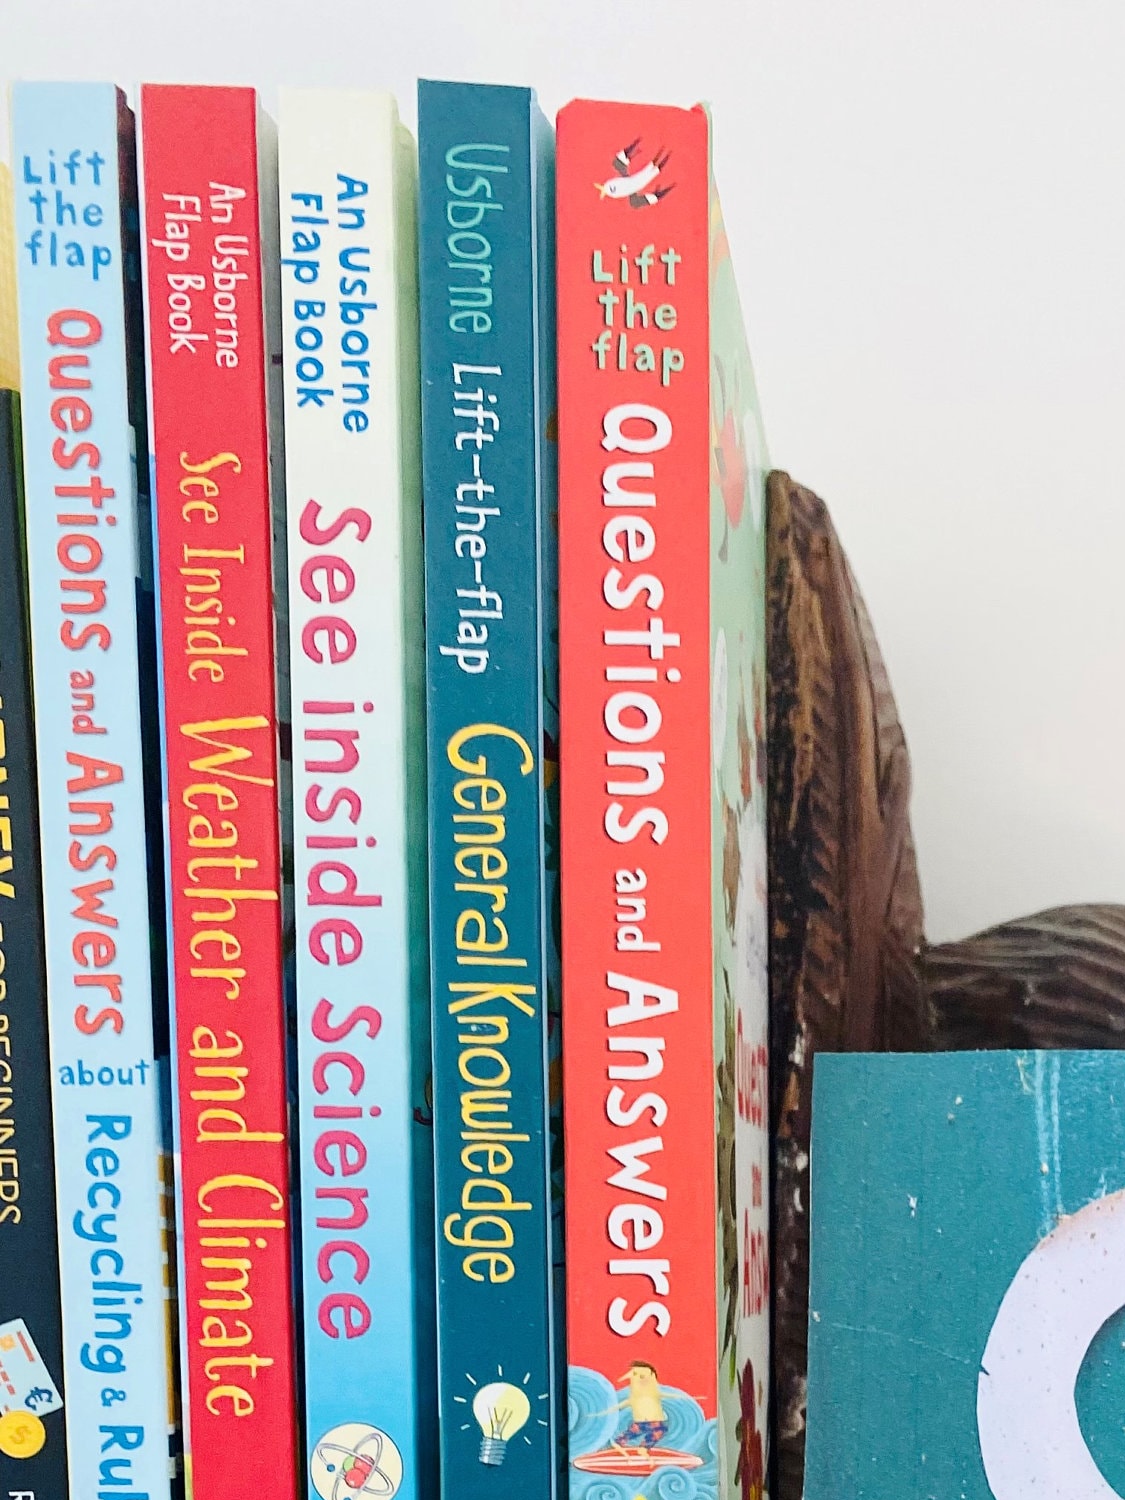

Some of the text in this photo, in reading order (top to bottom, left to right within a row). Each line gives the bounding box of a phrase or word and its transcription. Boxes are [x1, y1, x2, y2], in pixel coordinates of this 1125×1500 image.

[24, 150, 105, 185] Lift
[29, 190, 103, 227] the
[25, 230, 111, 281] flap
[151, 192, 209, 354] Flap Book
[209, 181, 249, 368] An Usborne
[281, 193, 334, 407] Flap Book
[337, 174, 377, 433] An Usborne
[593, 244, 682, 285] Lift
[598, 288, 678, 331] the
[592, 330, 685, 387] flap
[47, 309, 124, 1035] Questions and Answers
[440, 144, 536, 1283] Usborne Lift-the-flap General Knowledge
[178, 450, 285, 1416] See Inside Weather and Climate
[299, 499, 382, 1339] See inside Science
[602, 403, 681, 1336] Questions and Answers
[59, 1059, 150, 1086] about
[73, 1115, 143, 1373] Recycling
[101, 1388, 126, 1407] &
